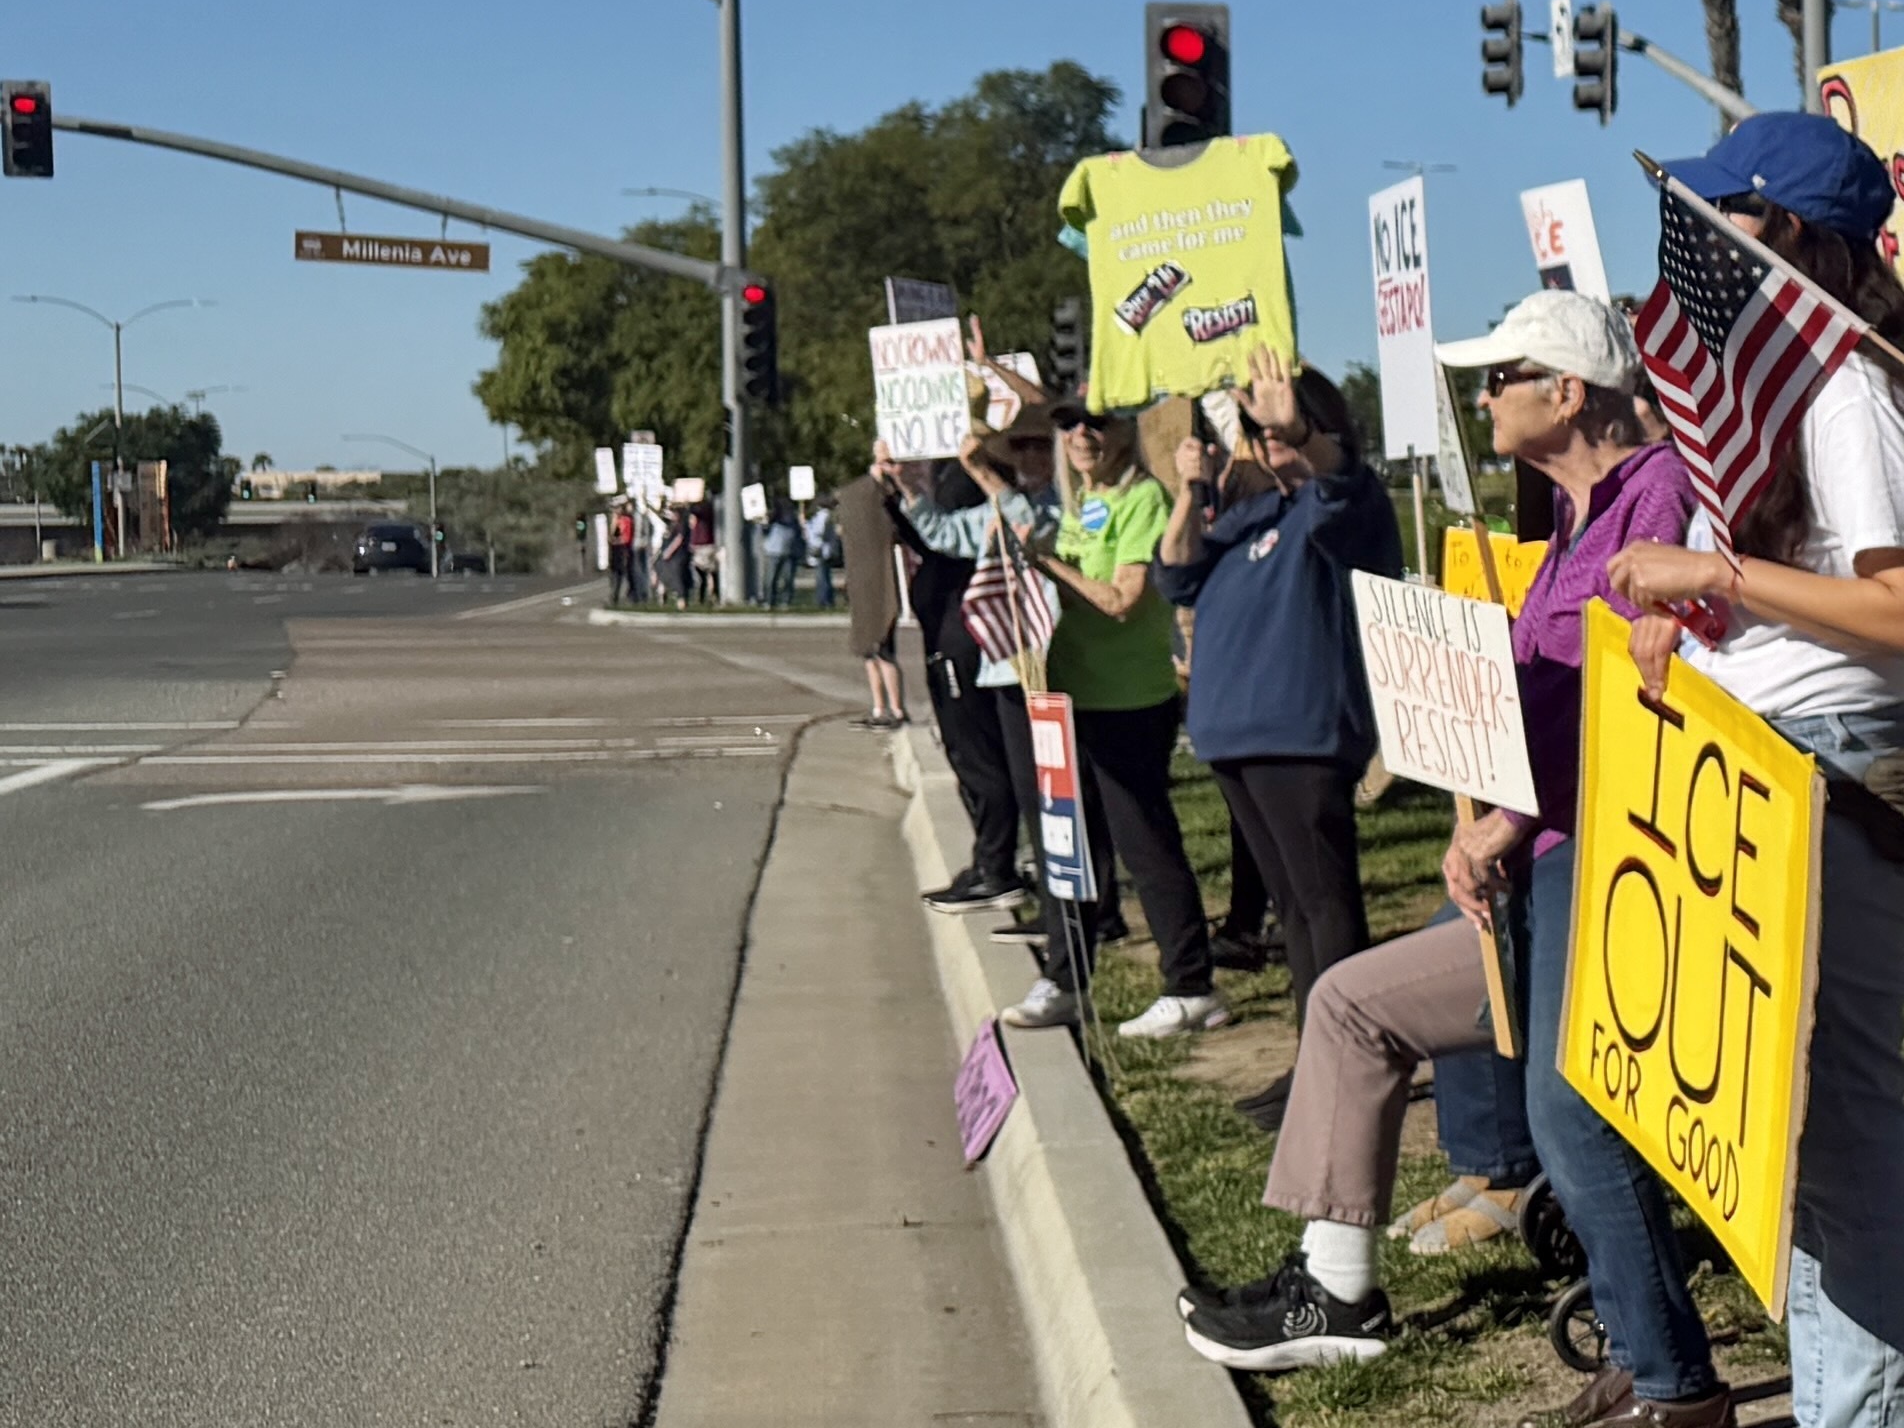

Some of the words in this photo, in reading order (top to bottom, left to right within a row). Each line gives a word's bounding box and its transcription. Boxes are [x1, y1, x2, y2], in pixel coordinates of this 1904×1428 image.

[342, 239, 422, 262] Millenia
[430, 245, 471, 266] Ave
[1110, 214, 1147, 241] and
[1153, 208, 1201, 230] then
[1207, 199, 1252, 220] they
[1177, 230, 1206, 250] for
[1213, 226, 1245, 244] me
[1395, 197, 1421, 271] ICE
[1369, 576, 1453, 646] SILENCE
[1461, 601, 1481, 653] IS
[1394, 699, 1496, 789] RESIST!
[1627, 685, 1771, 940] ICE
[1603, 856, 1772, 1148] OUT
[1590, 1020, 1642, 1122] FOR
[1665, 1094, 1740, 1223] GOOD
